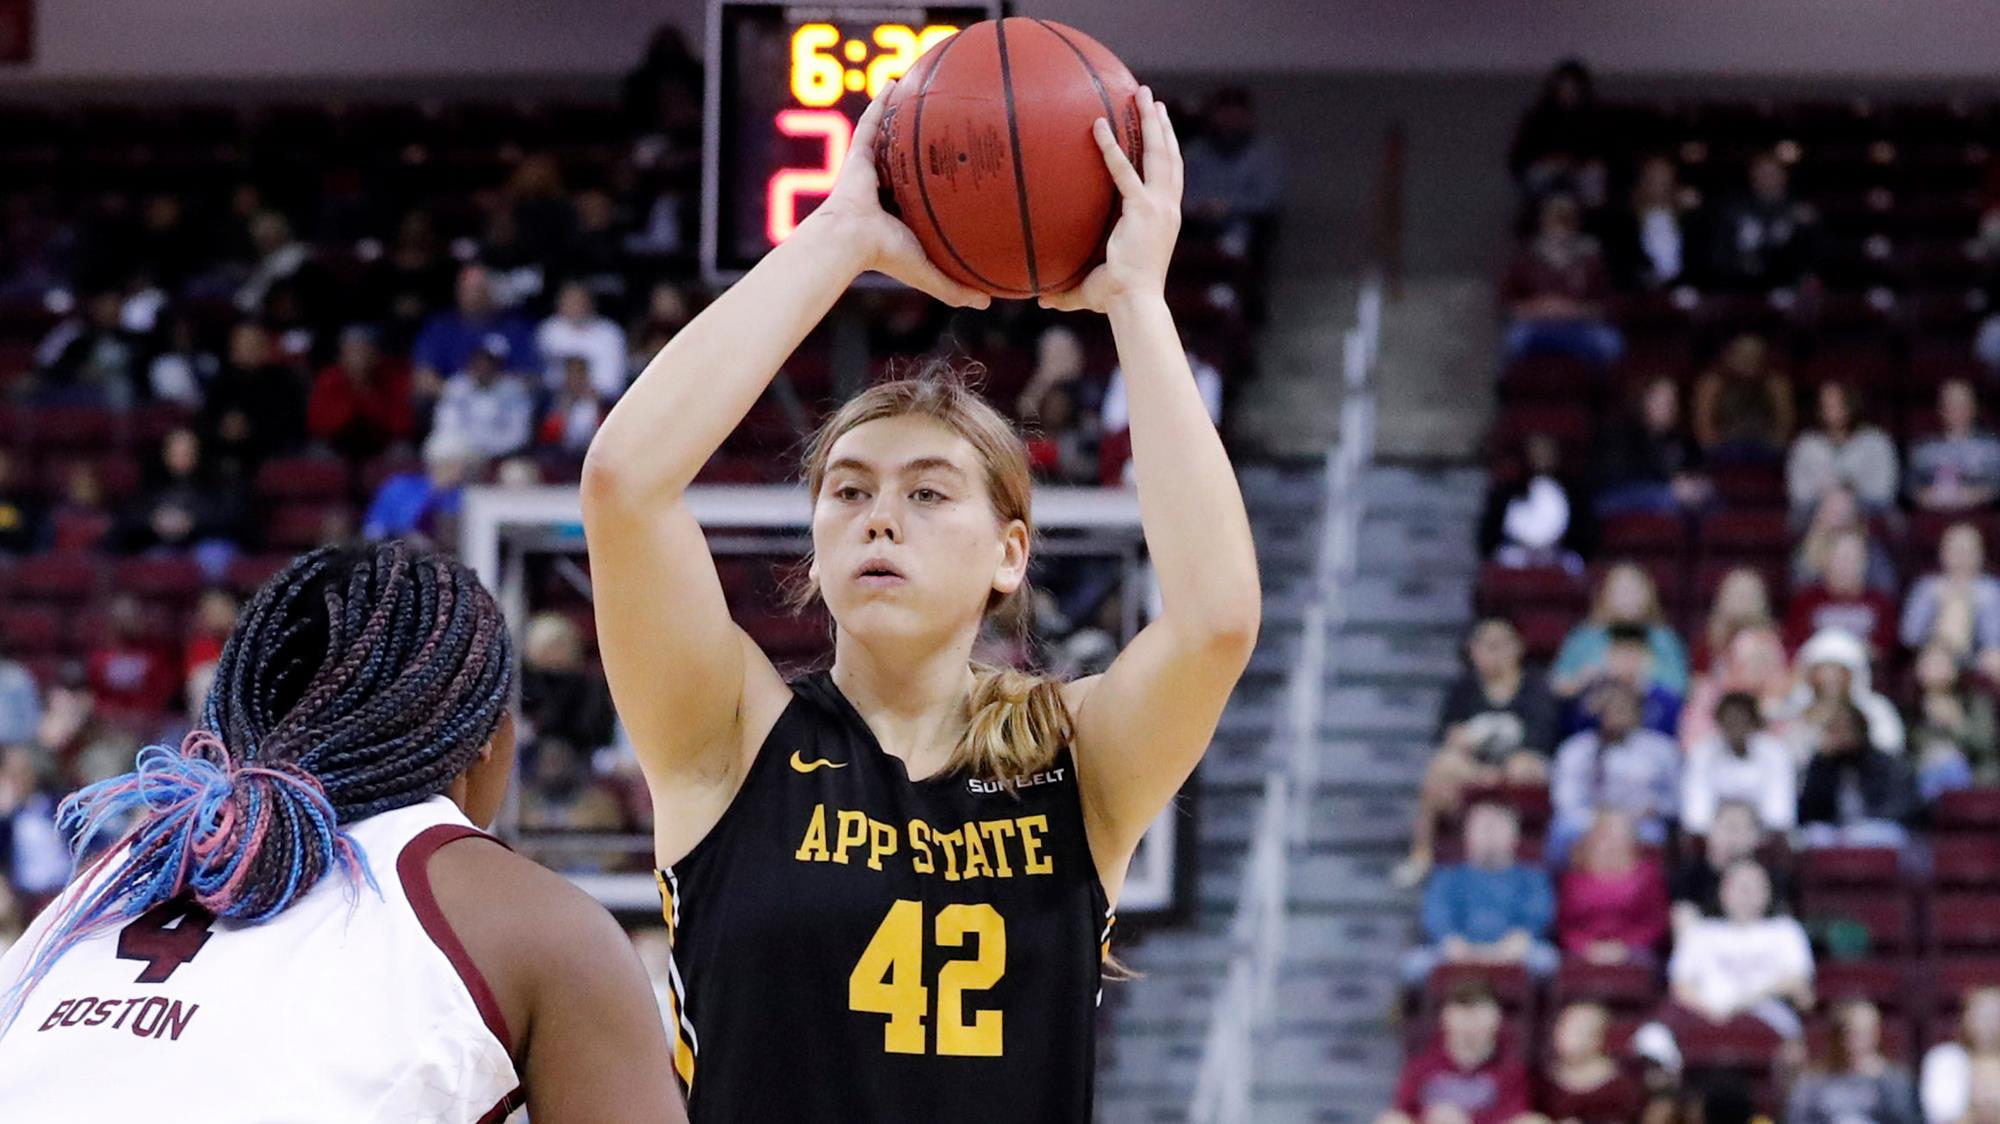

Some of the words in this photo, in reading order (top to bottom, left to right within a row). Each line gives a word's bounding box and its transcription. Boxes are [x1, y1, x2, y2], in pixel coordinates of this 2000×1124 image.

[795, 803, 898, 872] APP
[908, 814, 1054, 881] STATE
[116, 896, 215, 984] 4
[849, 899, 1007, 1057] 42
[37, 996, 200, 1041] BOSTON
